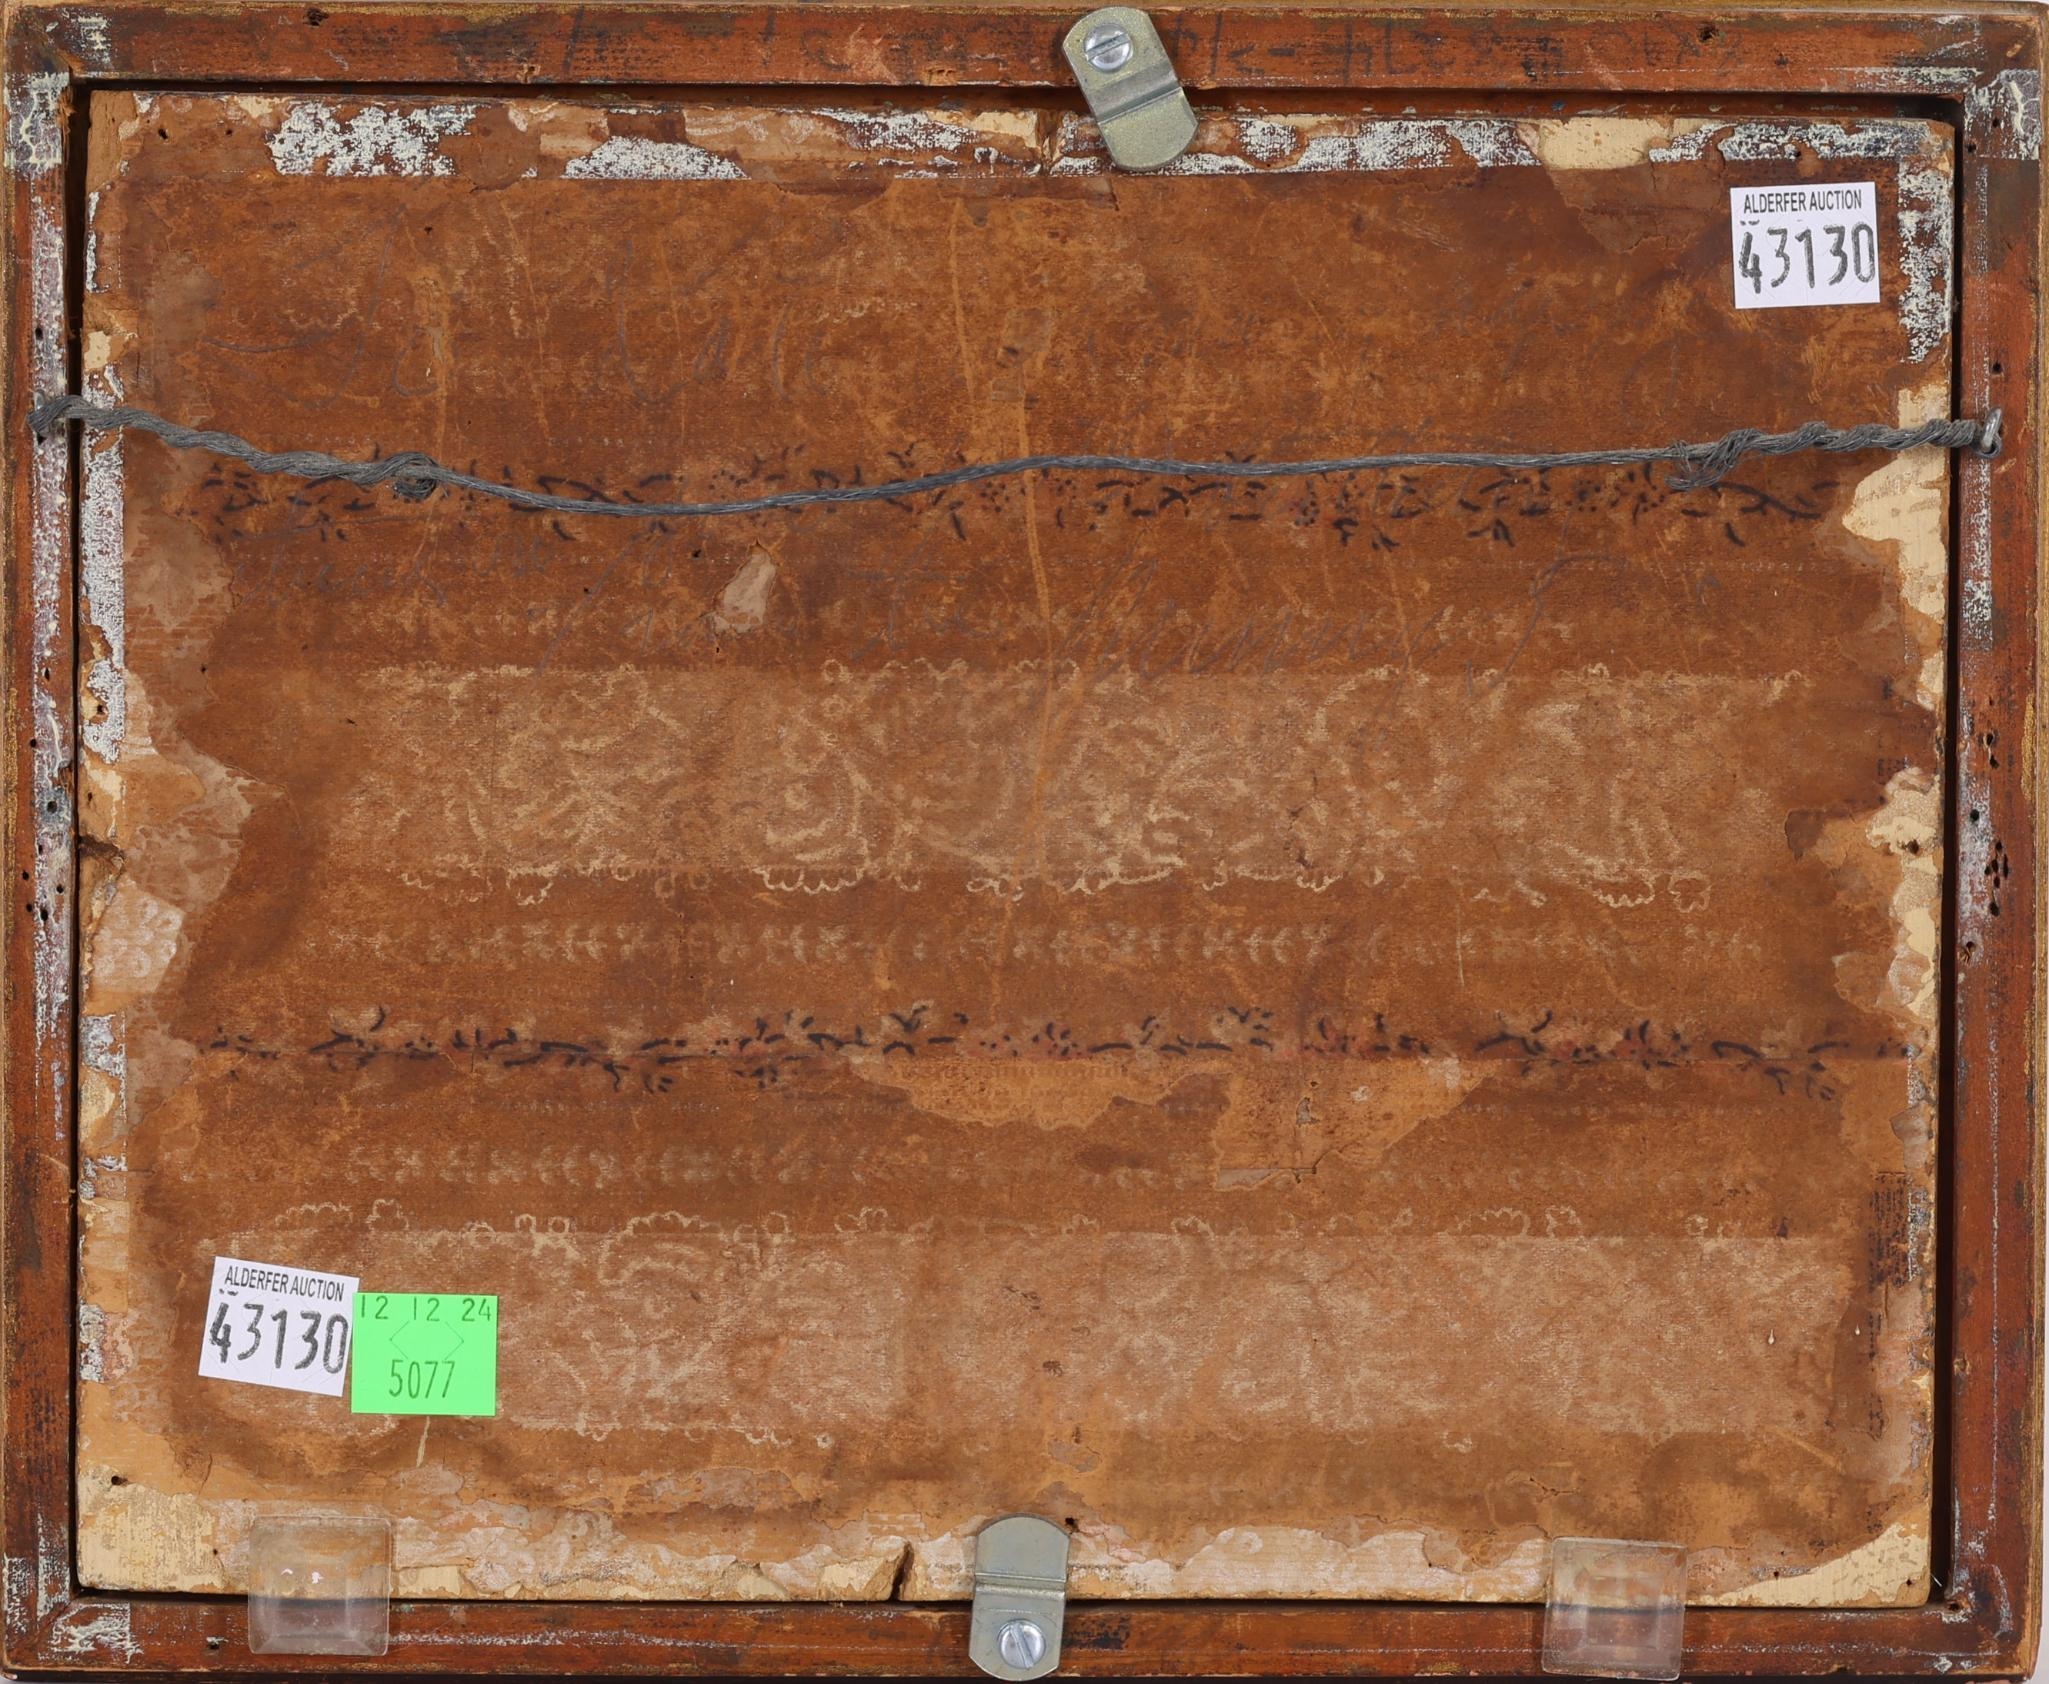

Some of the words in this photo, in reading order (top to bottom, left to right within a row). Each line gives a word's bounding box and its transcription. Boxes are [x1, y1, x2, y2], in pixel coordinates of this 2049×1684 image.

[1744, 191, 1807, 214] ALDERFER
[1809, 189, 1862, 211] AUCTION
[1738, 222, 1876, 294] 43130
[224, 1265, 289, 1294] ALDERFER
[290, 1276, 345, 1302] AUCTION
[360, 1296, 389, 1320] 12
[412, 1297, 440, 1322] 12
[462, 1298, 491, 1323] 24
[209, 1302, 350, 1374] 43130
[388, 1359, 455, 1399] 5077
